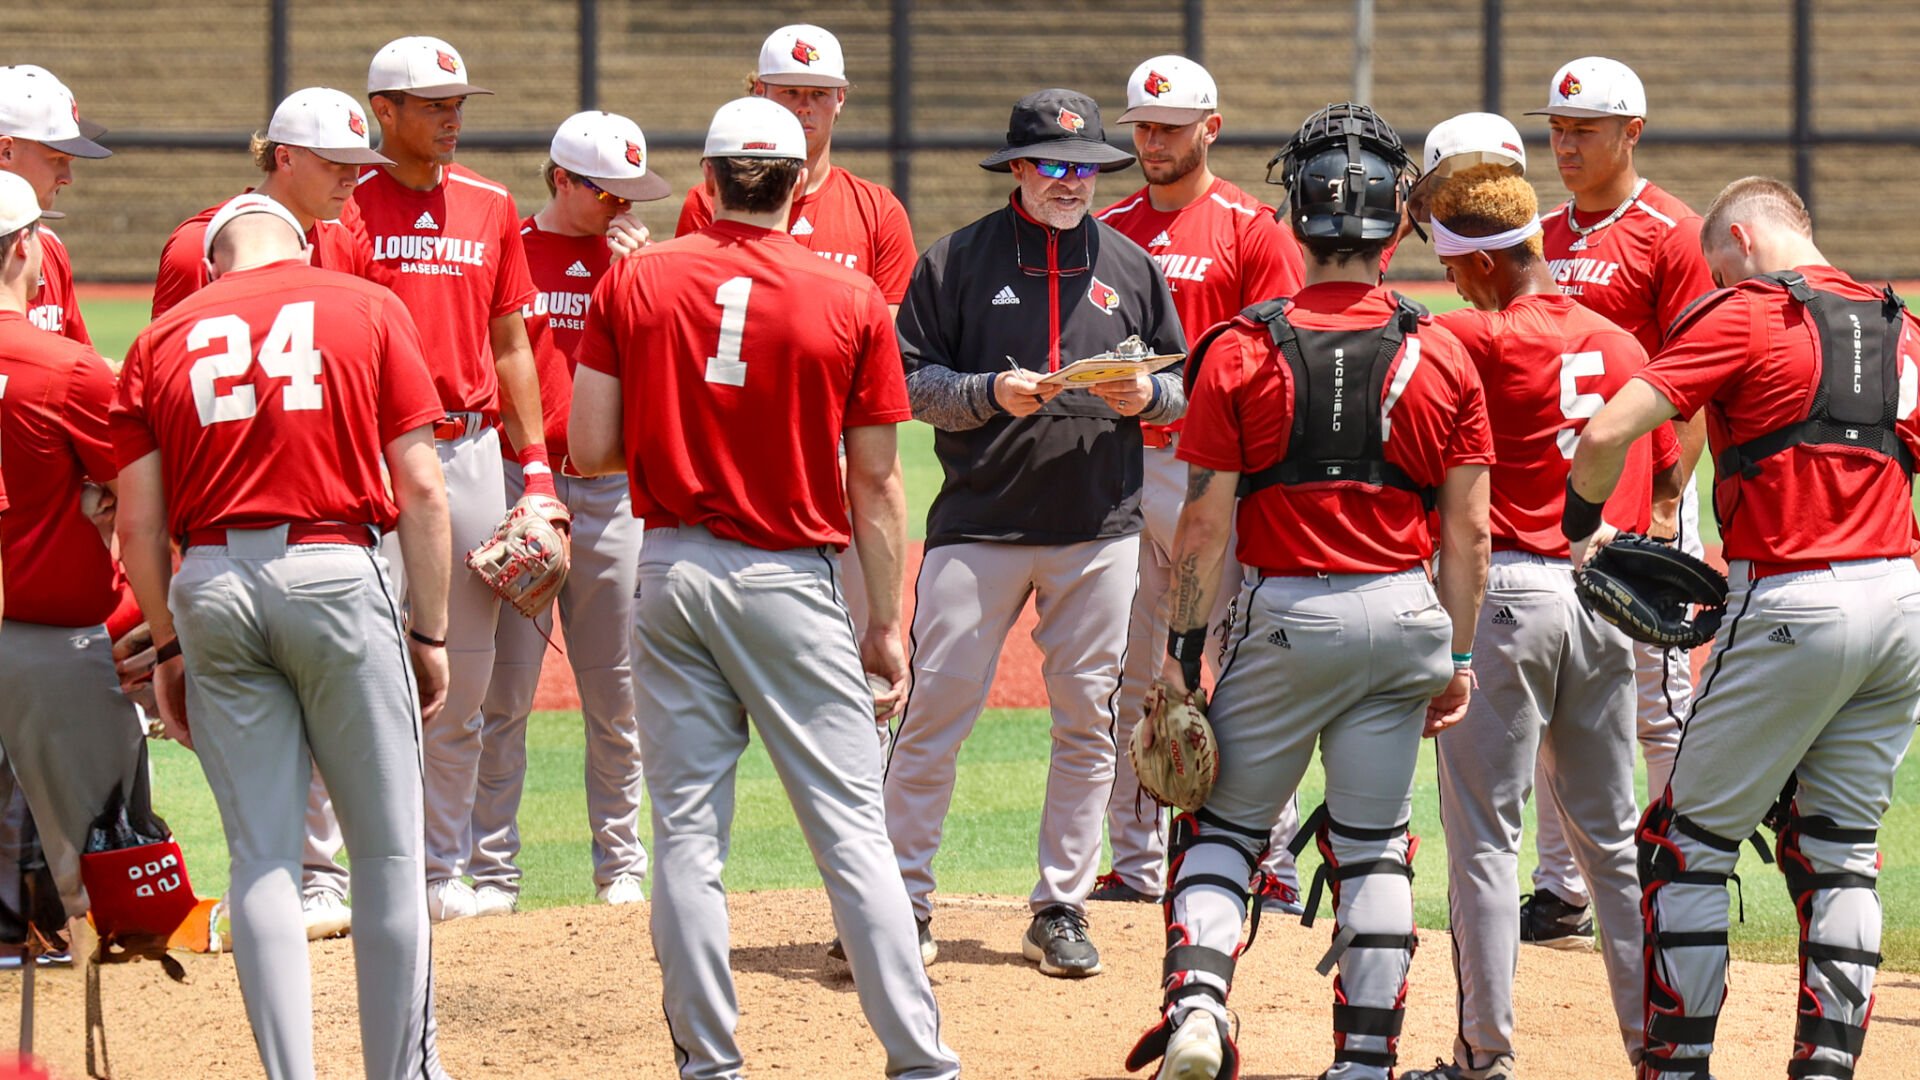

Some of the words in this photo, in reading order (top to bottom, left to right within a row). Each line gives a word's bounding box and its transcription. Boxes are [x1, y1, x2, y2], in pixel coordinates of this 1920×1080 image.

[373, 235, 484, 266] LOUISVILLE
[401, 262, 463, 276] BASEBALL
[186, 301, 323, 427] 24
[704, 276, 752, 387] 1
[1556, 351, 1606, 459] 5
